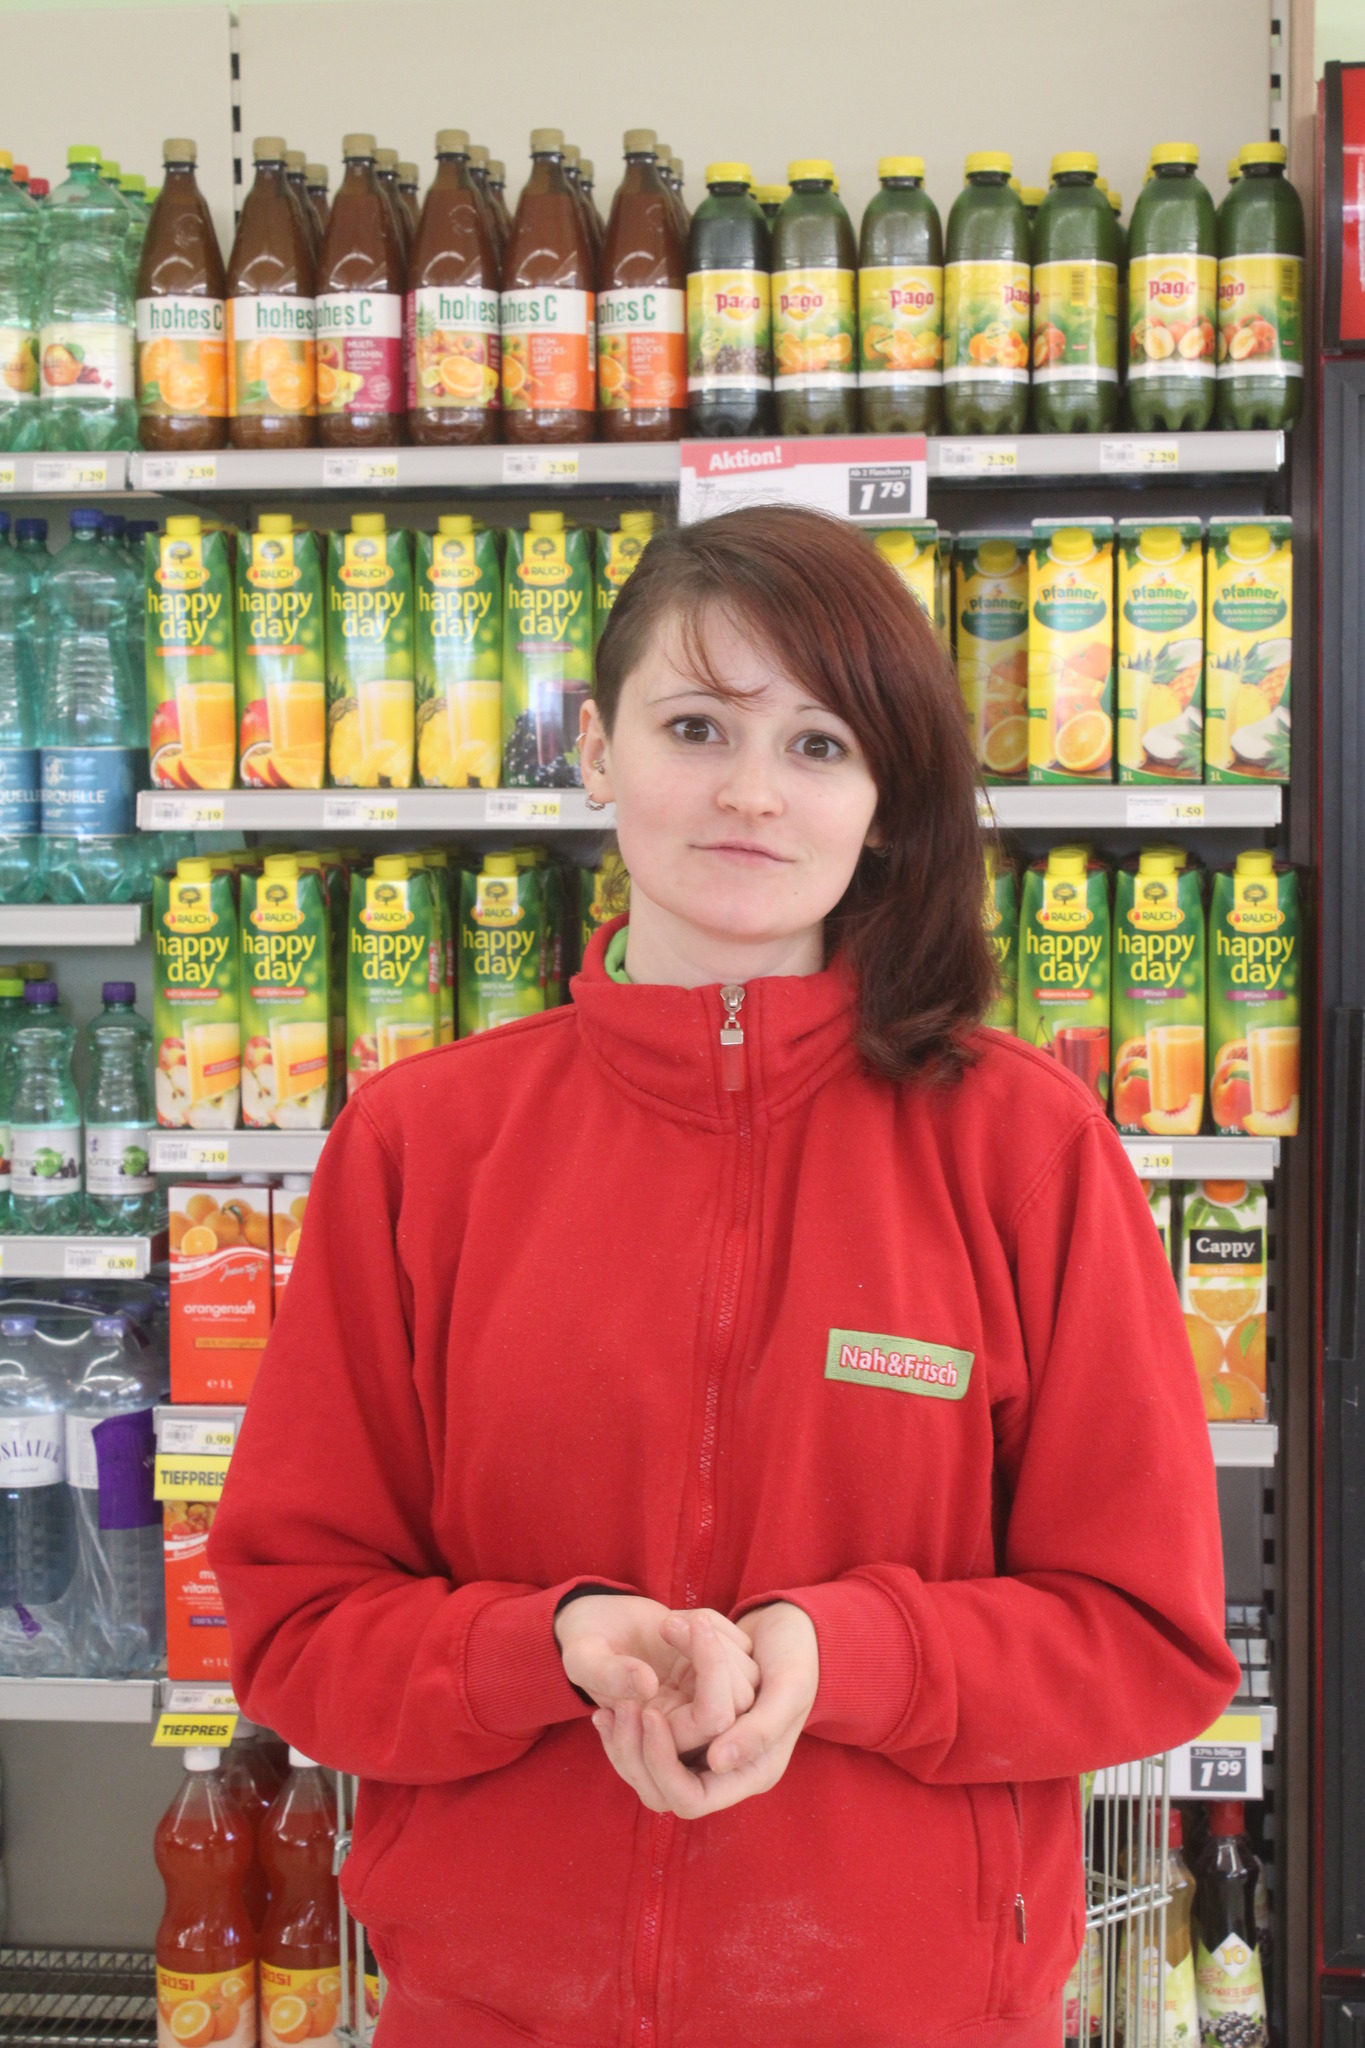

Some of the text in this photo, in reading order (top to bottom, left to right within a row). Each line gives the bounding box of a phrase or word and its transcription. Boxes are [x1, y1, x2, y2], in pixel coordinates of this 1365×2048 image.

[150, 302, 223, 331] hohes C
[256, 302, 313, 330] hohes
[359, 299, 372, 326] C
[439, 293, 496, 323] hohes
[544, 294, 557, 322] C
[643, 293, 656, 321] C
[709, 445, 782, 471] Aktion!
[988, 455, 1014, 466] 2.29
[1149, 452, 1175, 463] 2.29
[79, 472, 103, 482] 1.29
[188, 467, 214, 479] 2.39
[369, 466, 395, 478] 2.39
[550, 463, 576, 474] 2.39
[869, 468, 902, 476] Flaschen
[168, 570, 202, 579] RAUCH
[260, 569, 293, 579] RAUCH
[353, 569, 386, 578] RAUCH
[441, 569, 474, 578] RAUCH
[531, 567, 564, 576] RAUCH
[331, 585, 405, 618] happy
[419, 586, 492, 618] happy
[509, 583, 582, 616] happy
[1042, 583, 1099, 602] pfanner
[1132, 585, 1189, 601] pfanner
[1222, 584, 1279, 601] pfanner
[148, 588, 222, 620] happy
[240, 586, 313, 620] happy
[970, 596, 1024, 611] pfanner
[160, 613, 208, 646] day
[250, 612, 300, 645] day
[342, 612, 391, 644] day
[430, 612, 480, 644] day
[520, 609, 570, 642] day
[195, 809, 222, 821] 2.19
[368, 808, 395, 820] 2.19
[530, 804, 558, 816] 2.19
[1174, 806, 1202, 817] 1.59
[178, 914, 210, 924] RAUCH
[264, 913, 298, 922] RAUCH
[373, 912, 406, 922] RAUCH
[484, 908, 516, 918] RAUCH
[1052, 912, 1086, 922] RAUCH
[1142, 912, 1177, 921] RAUCH
[1242, 914, 1278, 923] RAUCH
[156, 929, 230, 964] happy
[242, 928, 316, 962] happy
[352, 928, 425, 962] happy
[462, 924, 534, 956] happy
[1026, 928, 1102, 964] happy
[1118, 928, 1195, 963] happy
[1216, 928, 1295, 964] happy
[167, 956, 217, 989] day
[254, 954, 303, 988] day
[362, 957, 411, 987] day
[474, 951, 522, 982] day
[1039, 958, 1090, 990] day
[1130, 957, 1182, 989] day
[1230, 958, 1282, 990] day
[200, 1152, 225, 1163] 2.19
[1143, 1157, 1170, 1168] 2.19
[1196, 1237, 1256, 1258] Cappy
[108, 1258, 134, 1270] 0.89
[184, 1300, 256, 1318] orangensaft
[840, 1344, 958, 1387] Nah&Frisch
[206, 1434, 231, 1445] 0.99
[160, 1470, 227, 1487] TIEFPREIS
[162, 1725, 229, 1736] TIEFPREIS
